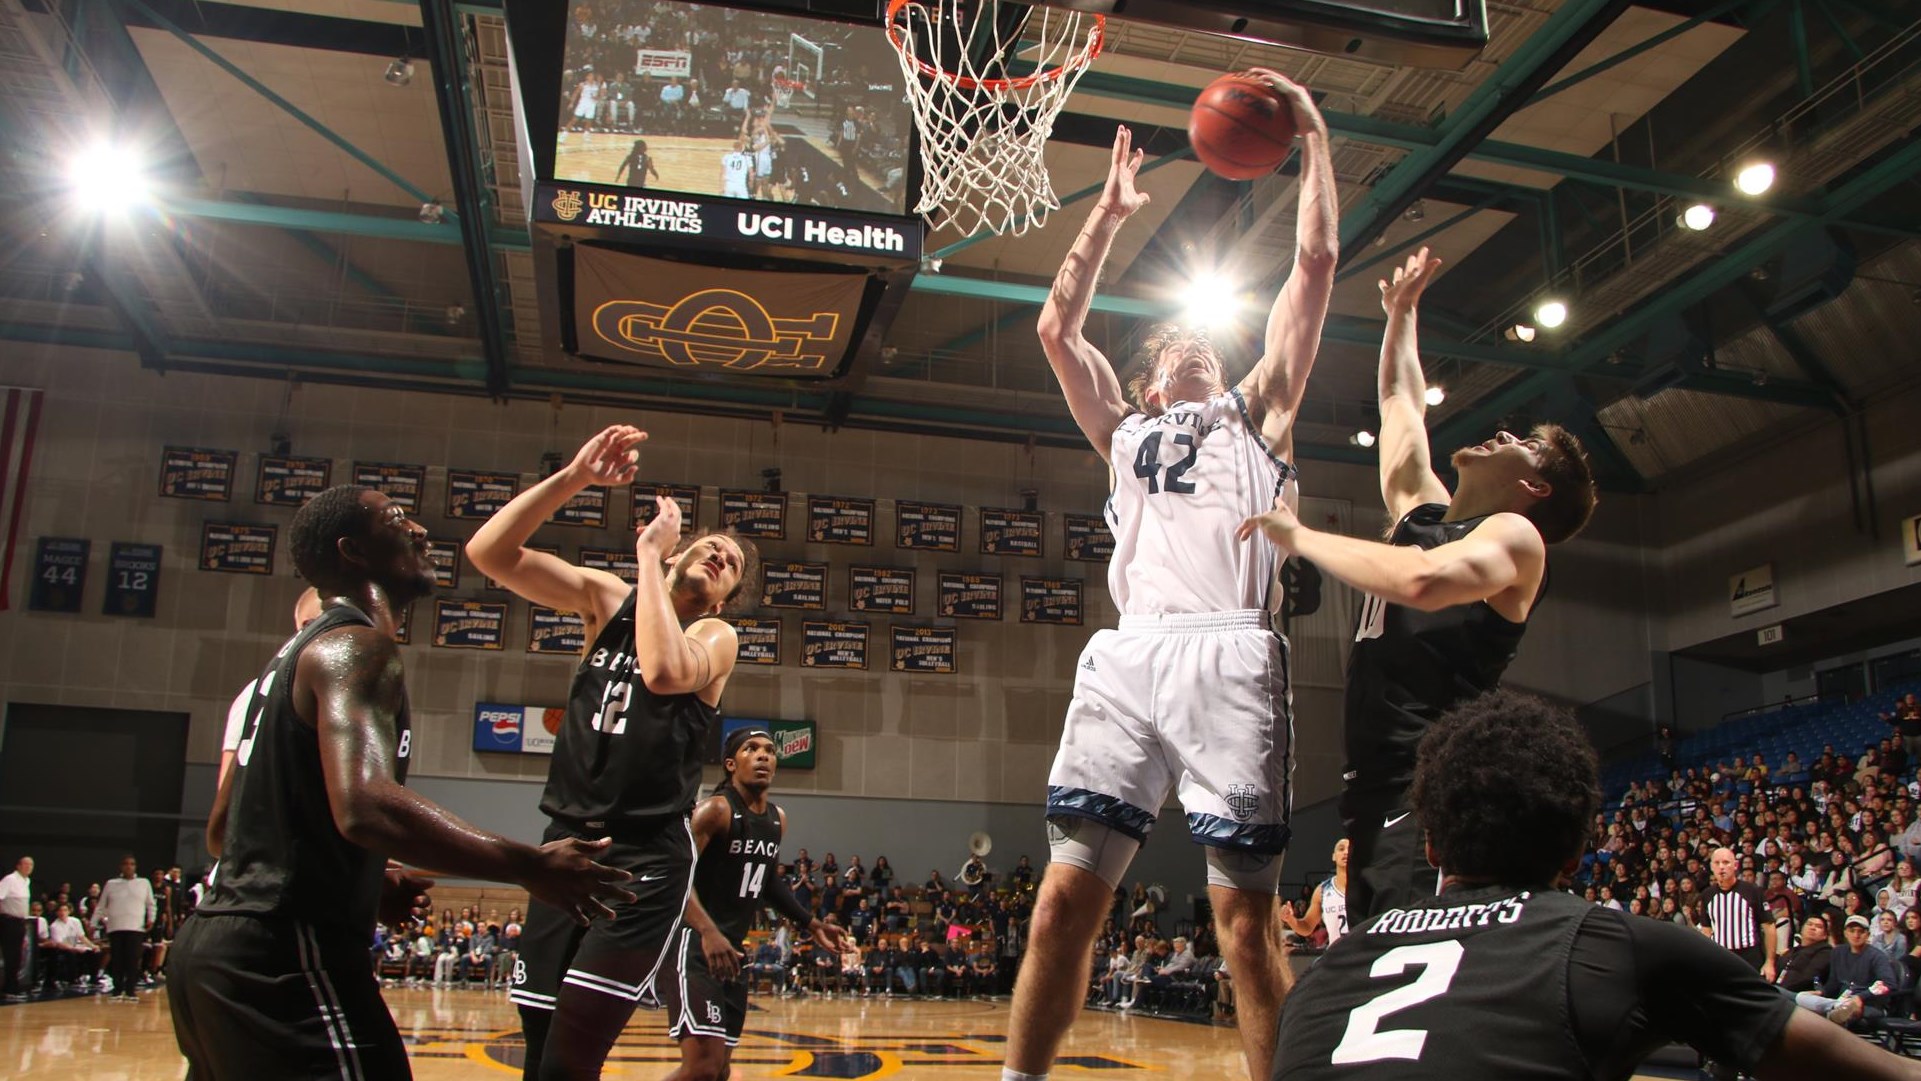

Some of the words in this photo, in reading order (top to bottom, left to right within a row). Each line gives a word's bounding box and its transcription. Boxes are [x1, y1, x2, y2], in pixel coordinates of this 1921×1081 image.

[641, 54, 688, 69] ESPN
[588, 192, 618, 210] UC
[624, 196, 699, 219] IRVINE
[586, 209, 703, 234] ATHLETICS
[737, 212, 793, 240] UCI
[804, 219, 904, 252] Health
[1133, 431, 1197, 494] 42
[43, 566, 77, 585] 44
[118, 571, 149, 590] 12
[478, 711, 522, 723] PEPSI
[728, 839, 779, 858] BEACH
[739, 862, 767, 898] 14
[1331, 939, 1465, 1065] 2
